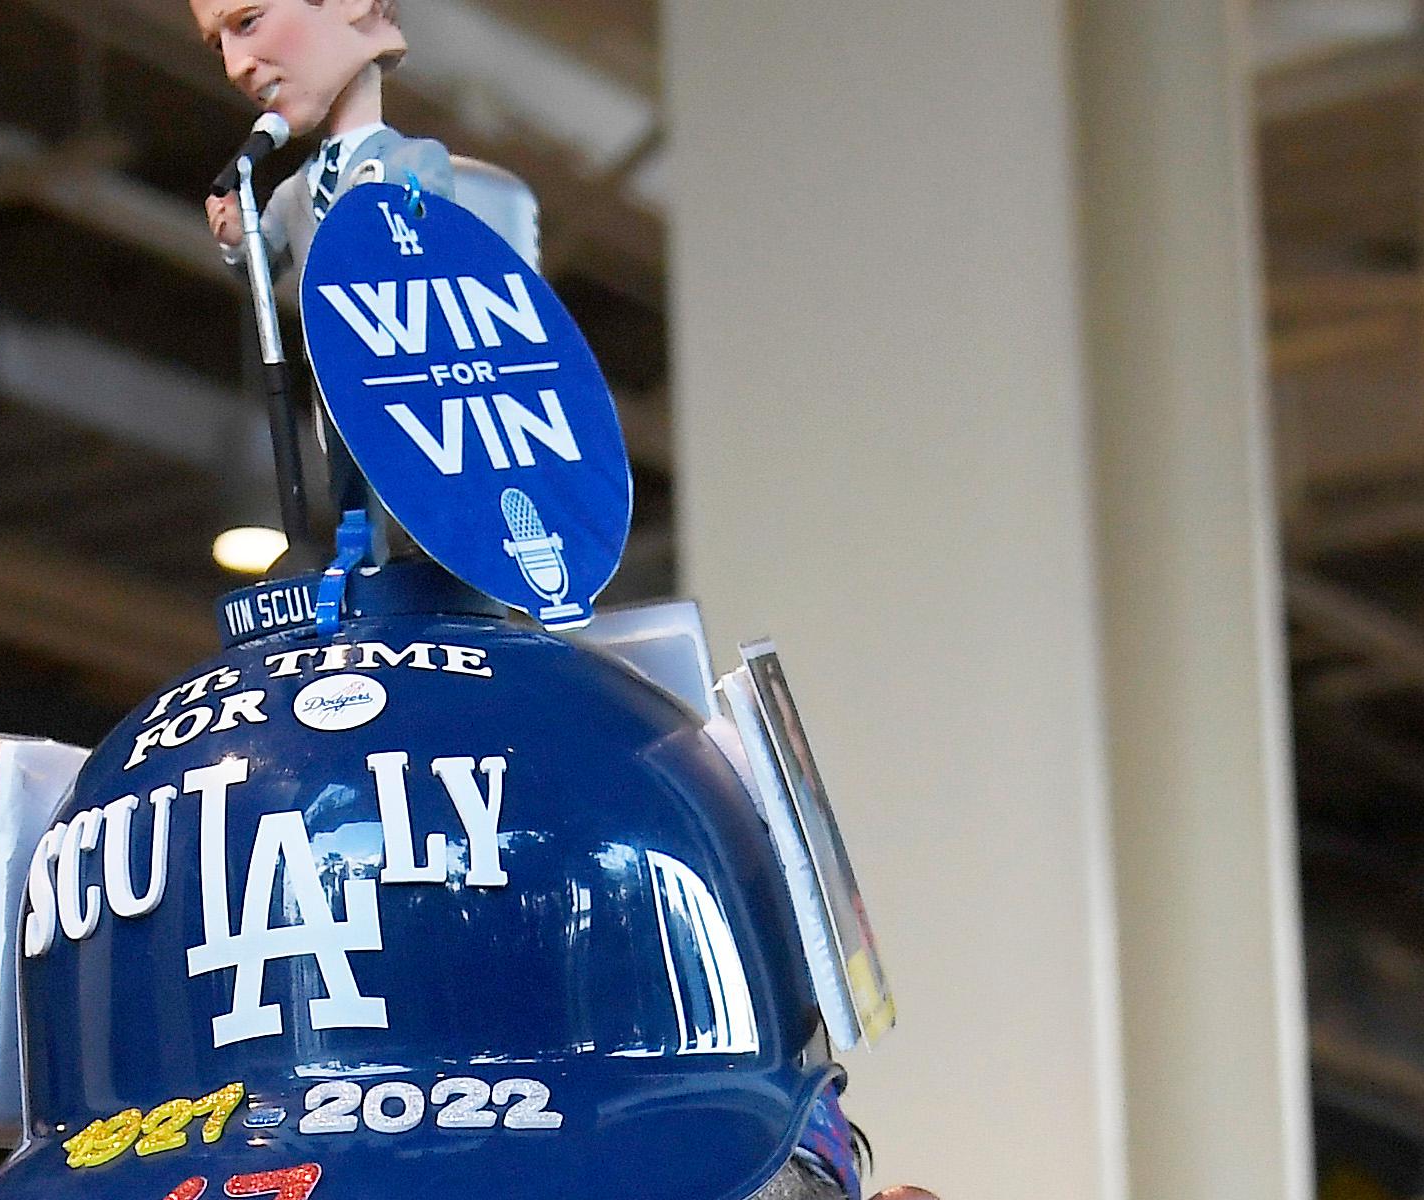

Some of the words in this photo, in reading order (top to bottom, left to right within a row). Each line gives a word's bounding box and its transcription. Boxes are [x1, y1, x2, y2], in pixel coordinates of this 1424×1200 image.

[377, 201, 424, 255] LA
[317, 272, 548, 357] WIN
[430, 361, 496, 387] FOR
[384, 388, 582, 476] VIN
[225, 598, 255, 636] VIN
[257, 585, 318, 629] SCUL
[264, 641, 493, 679] TIME
[302, 692, 374, 712] Dodgers
[123, 689, 268, 771] FOR
[298, 1077, 564, 1134] 2022
